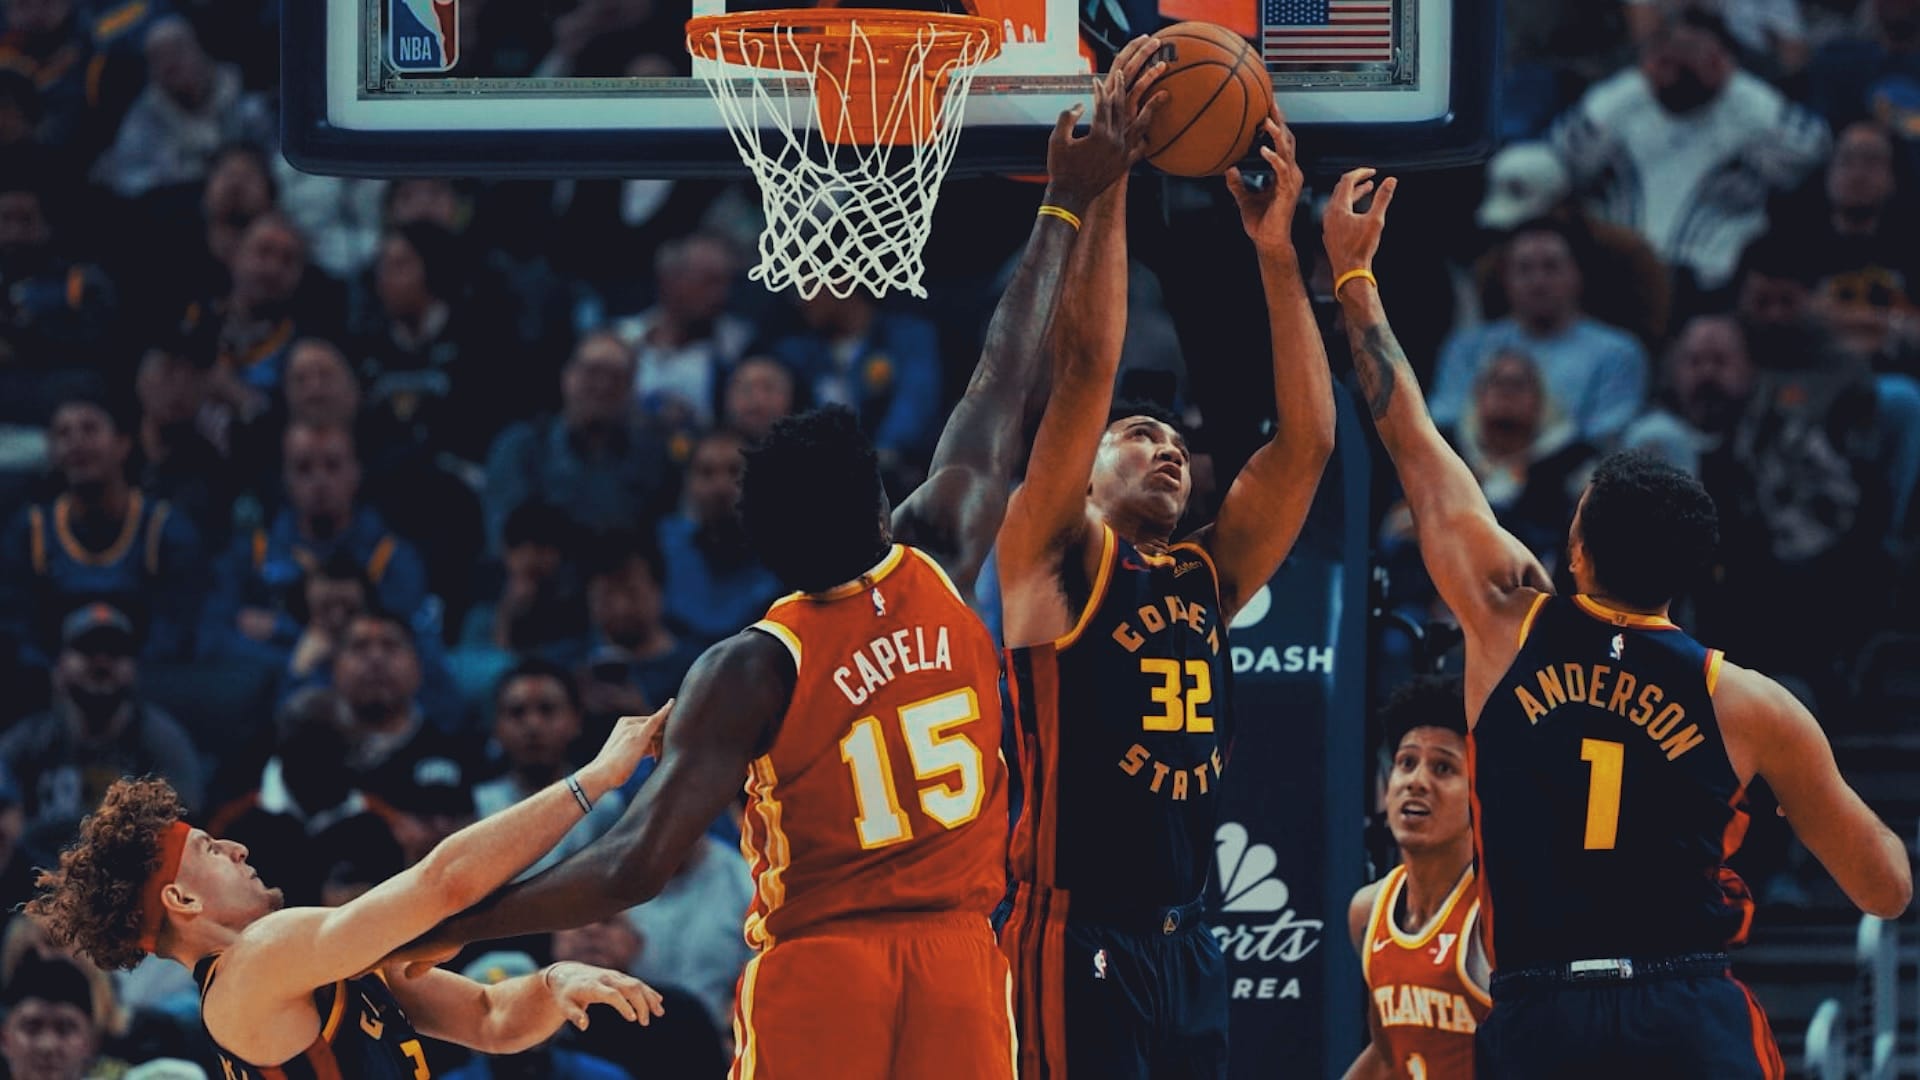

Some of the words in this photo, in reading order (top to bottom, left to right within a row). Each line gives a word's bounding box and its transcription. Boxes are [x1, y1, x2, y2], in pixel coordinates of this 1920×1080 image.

[400, 35, 432, 61] NBA
[833, 626, 952, 705] CAPELA
[1140, 658, 1214, 733] 32
[1514, 662, 1705, 761] ANDERSON
[839, 686, 985, 849] 15
[1118, 743, 1223, 801] STATE
[1581, 738, 1624, 850] 1
